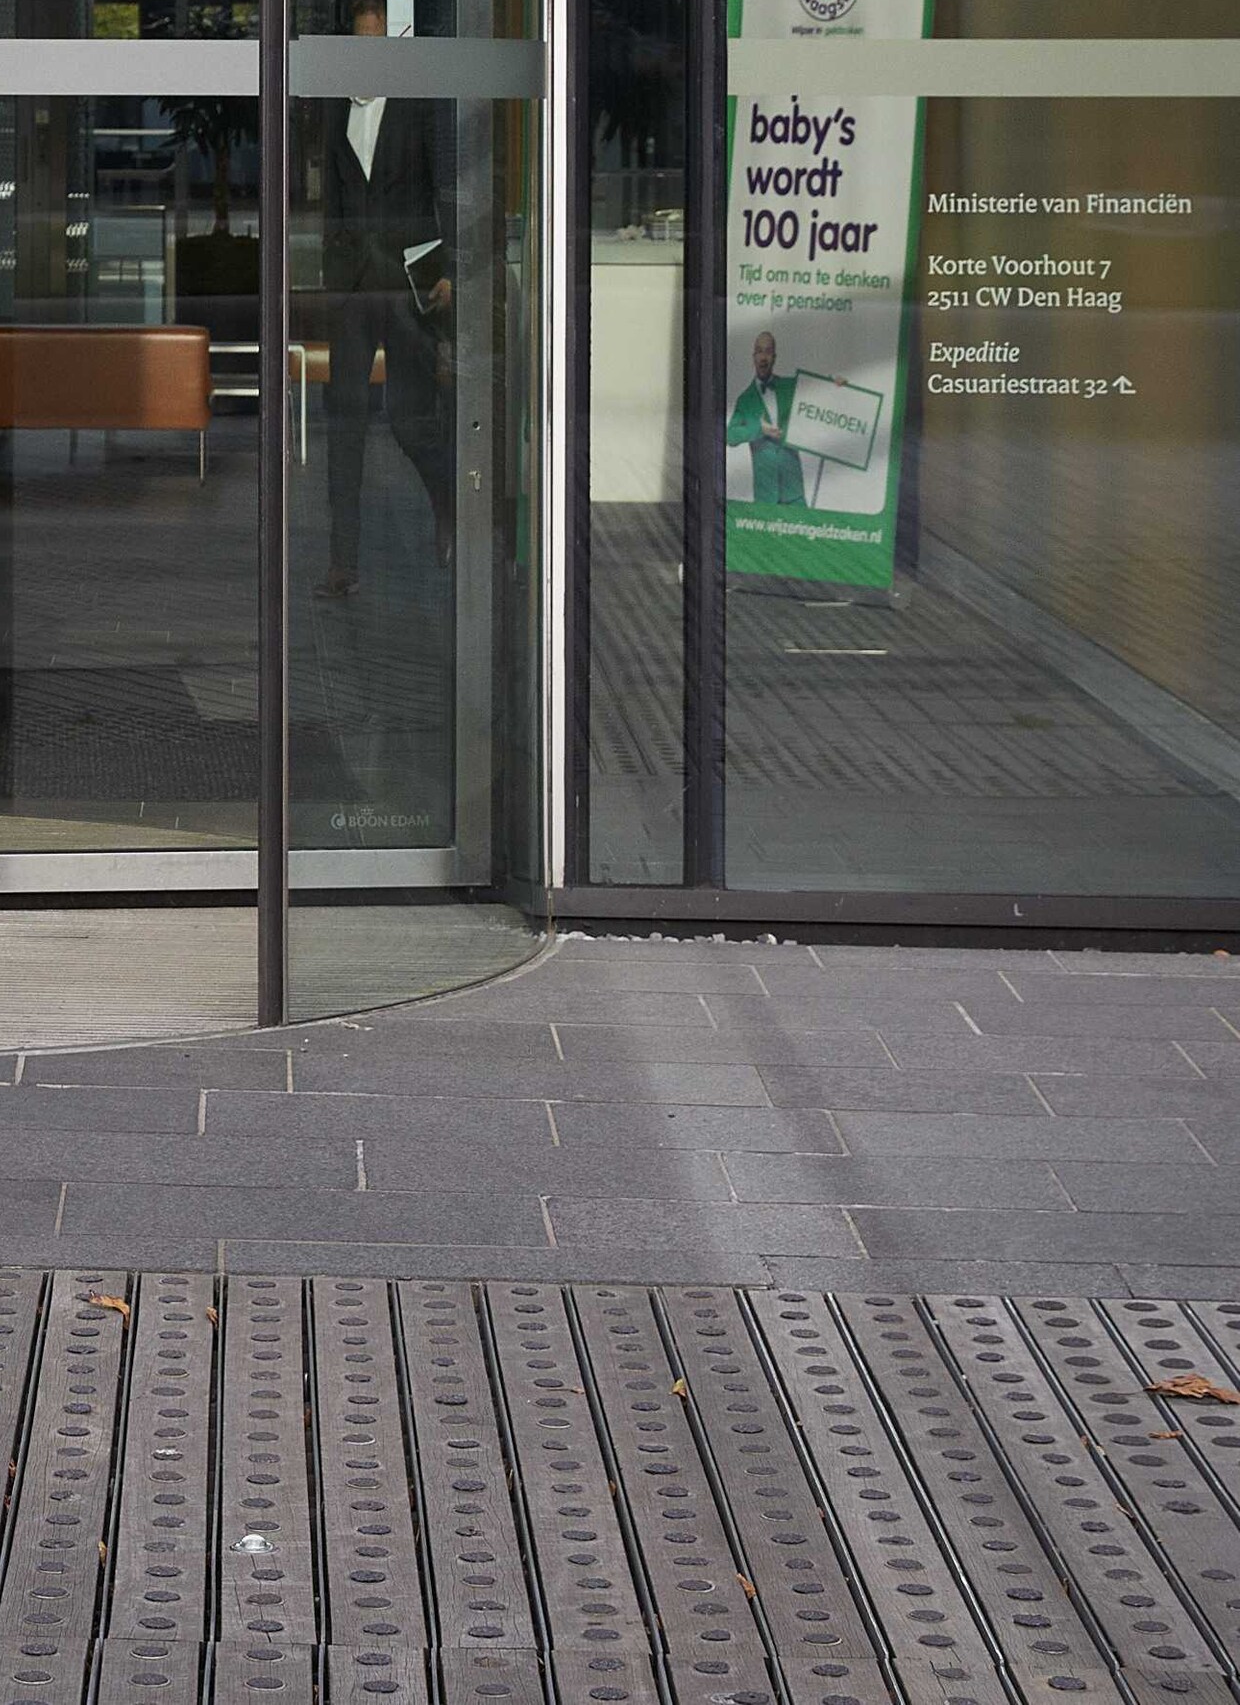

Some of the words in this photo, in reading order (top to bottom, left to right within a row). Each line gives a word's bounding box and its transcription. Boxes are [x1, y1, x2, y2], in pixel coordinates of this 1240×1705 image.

[750, 102, 856, 155] baby's
[747, 157, 843, 197] wordt
[928, 192, 1037, 214] Ministerie
[1042, 197, 1080, 213] van
[1086, 192, 1192, 214] Financiën
[743, 209, 799, 249] 100
[808, 209, 878, 261] jaar
[739, 264, 762, 286] Tijd
[766, 268, 789, 284] om
[793, 269, 811, 285] na
[816, 268, 830, 286] te
[835, 269, 890, 289] denken
[928, 255, 987, 275] Korte
[992, 254, 1095, 276] Voorhout
[1099, 260, 1112, 279] 7
[736, 292, 766, 307] over
[771, 290, 783, 311] je
[787, 292, 853, 312] pensioen
[928, 291, 969, 310] 2511
[976, 287, 1012, 307] CW
[1017, 287, 1061, 307] Den
[1066, 288, 1122, 314] Haag
[929, 341, 1020, 368] Expeditie
[928, 373, 1079, 394] Casuariestraat
[1084, 380, 1108, 399] 32
[798, 401, 868, 435] PENSIOEN
[348, 814, 388, 827] BOON
[390, 814, 430, 827] EDAM
